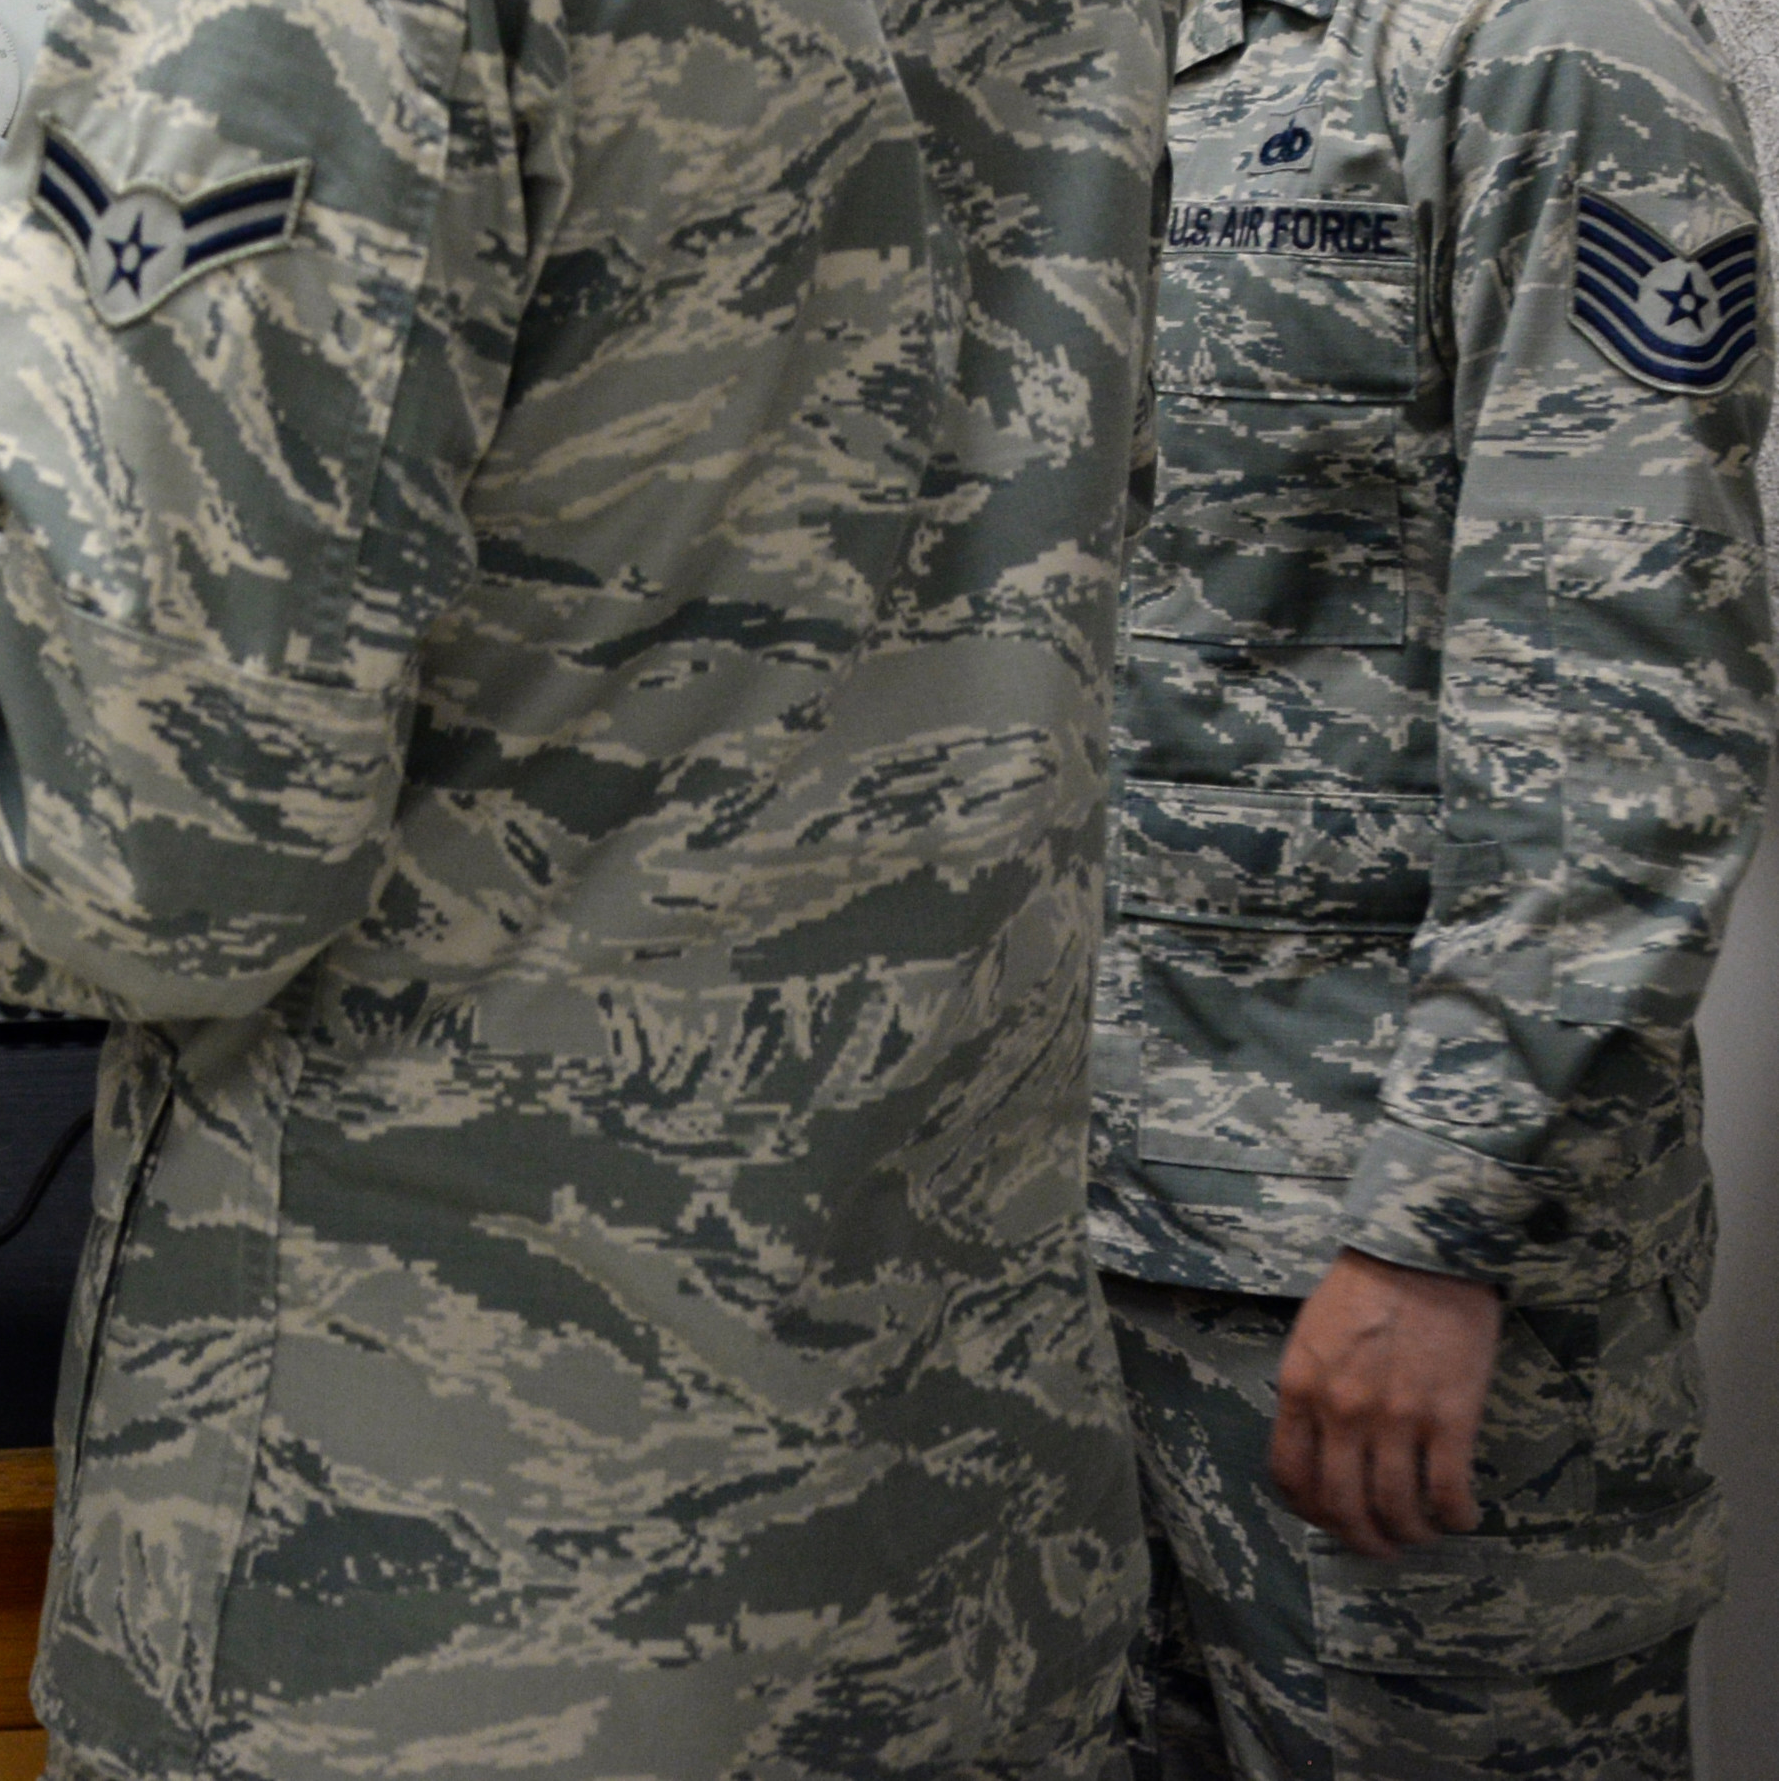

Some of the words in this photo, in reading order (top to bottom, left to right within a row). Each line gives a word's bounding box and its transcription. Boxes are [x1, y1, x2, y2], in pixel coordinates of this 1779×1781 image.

[1169, 206, 1212, 247] U.S.
[1216, 205, 1264, 248] AIR
[1269, 207, 1403, 255] FORCE
